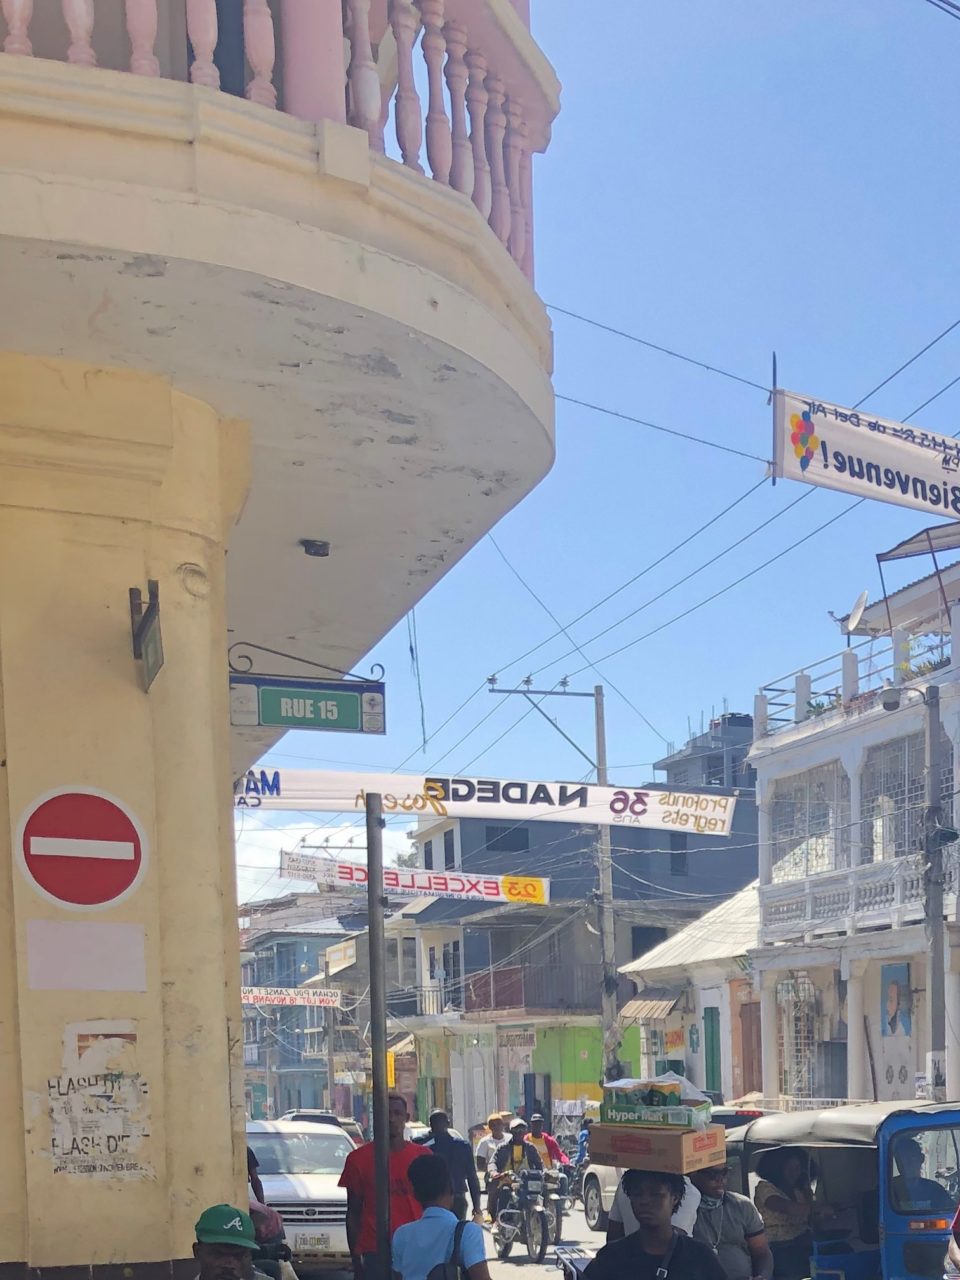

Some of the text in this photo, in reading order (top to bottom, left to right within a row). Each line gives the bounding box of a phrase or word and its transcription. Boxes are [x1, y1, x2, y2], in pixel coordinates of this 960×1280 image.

[280, 697, 339, 720] RUE 15
[607, 1108, 641, 1122] Hyper
[223, 1217, 243, 1231] A
